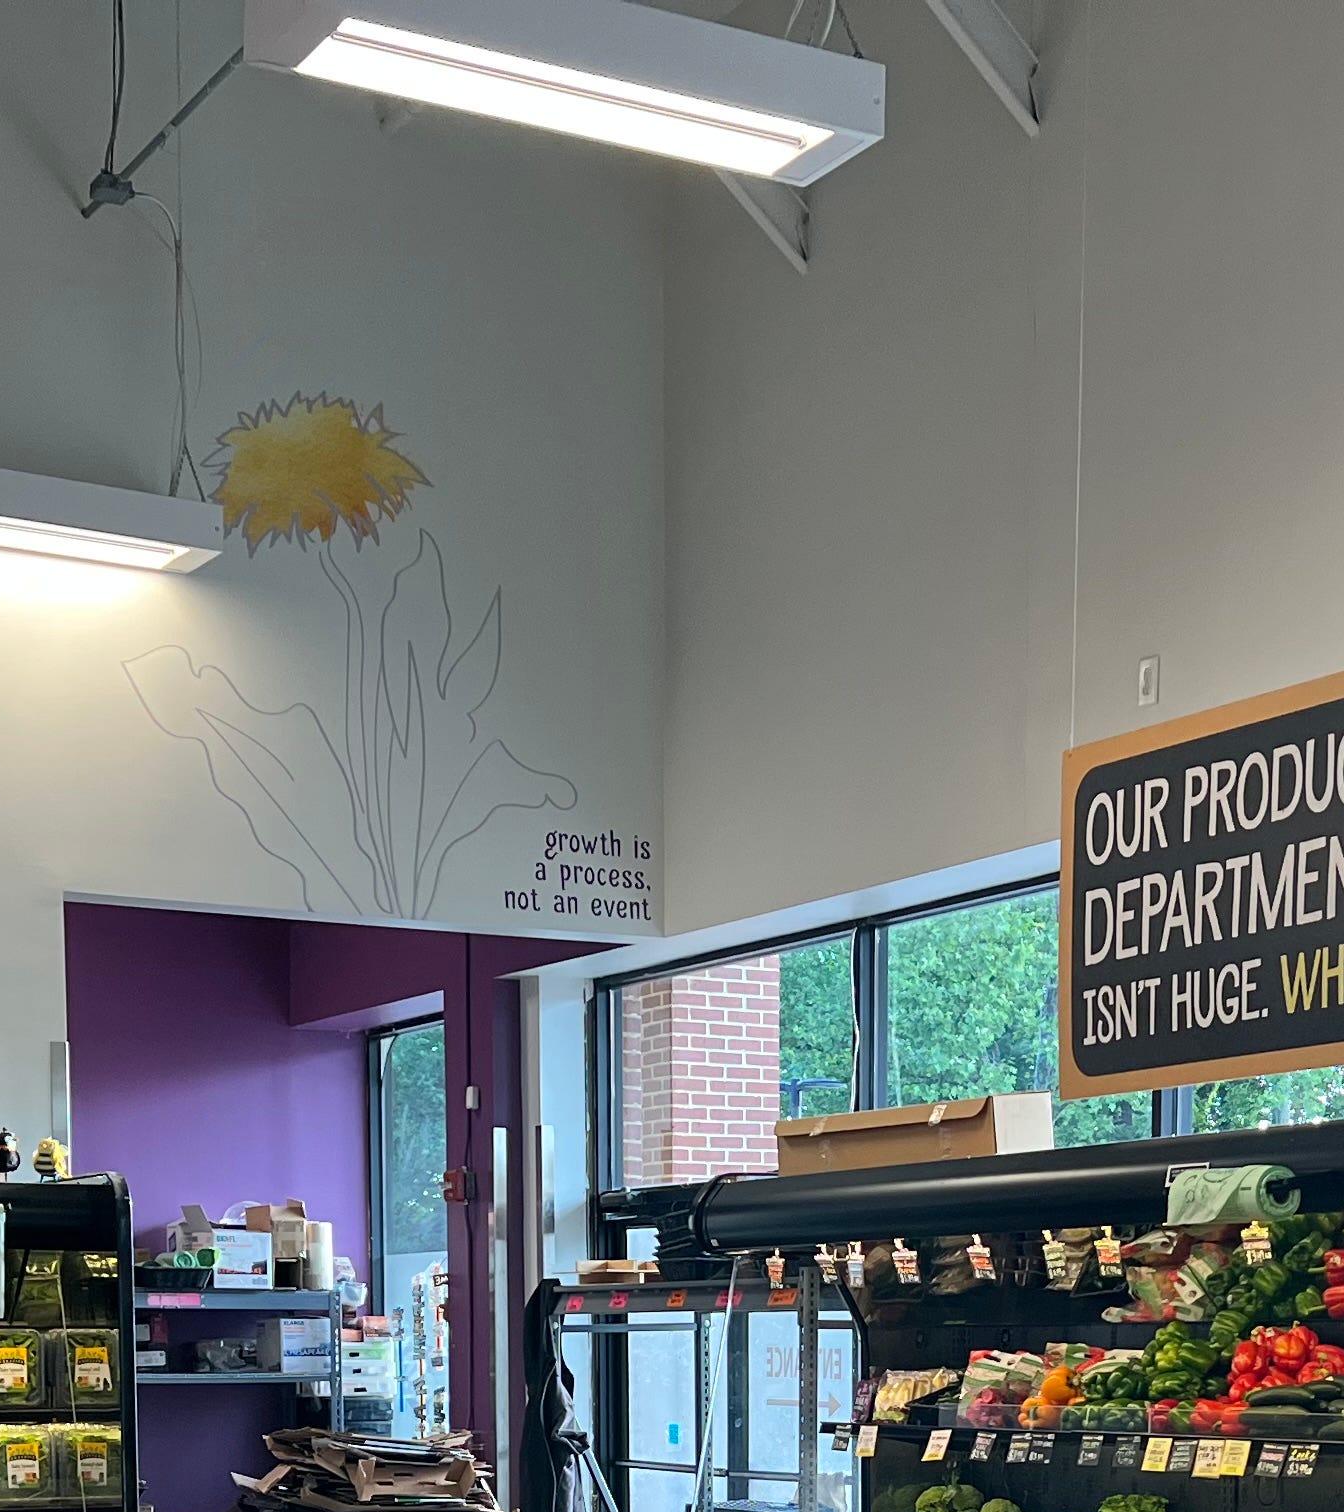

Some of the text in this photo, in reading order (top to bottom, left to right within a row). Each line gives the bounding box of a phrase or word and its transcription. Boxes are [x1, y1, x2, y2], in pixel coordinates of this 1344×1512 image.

[1085, 778, 1171, 867] OUR
[544, 830, 651, 860] growth is
[535, 862, 651, 891] a process,
[504, 889, 652, 921] not an event
[1082, 978, 1161, 1047] ISN'T
[1170, 958, 1270, 1033] HUGE.
